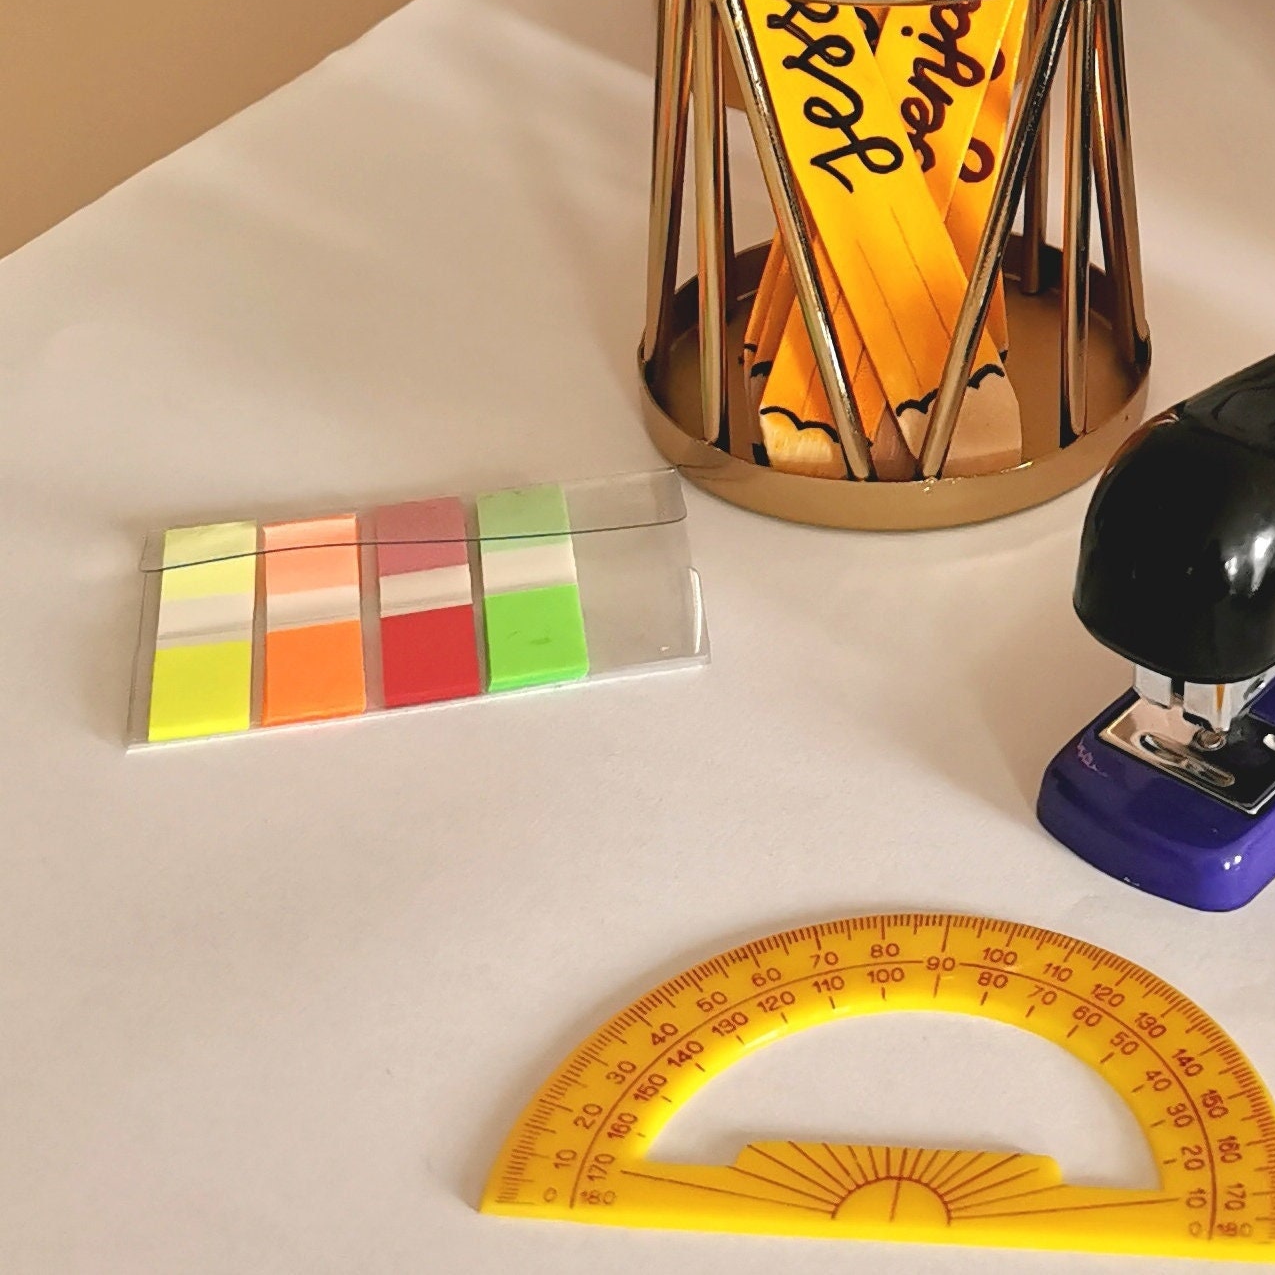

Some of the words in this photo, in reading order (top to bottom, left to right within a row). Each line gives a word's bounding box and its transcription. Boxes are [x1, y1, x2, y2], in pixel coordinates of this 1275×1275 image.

[811, 974, 846, 994] 110
[866, 966, 906, 984] 100
[976, 971, 1009, 990] 80
[756, 990, 797, 1014] 120
[1026, 984, 1058, 1007] 70
[1071, 1005, 1104, 1028] 60
[553, 1148, 578, 1170] 10
[573, 1103, 603, 1130] 20
[605, 1060, 637, 1085] 30
[650, 1022, 679, 1046] 40
[696, 991, 728, 1013] 50
[751, 967, 782, 988] 60
[809, 951, 840, 969] 70
[869, 942, 900, 959] 80
[926, 956, 956, 973] 90
[981, 946, 1019, 966] 100
[1042, 962, 1075, 983] 110
[1089, 982, 1126, 1009] 120
[1133, 1011, 1168, 1040] 130
[1171, 1047, 1204, 1079] 140
[666, 1040, 705, 1068] 140
[1109, 1030, 1139, 1057] 50
[632, 1073, 669, 1103] 150
[1145, 1069, 1173, 1092] 40
[606, 1111, 639, 1140] 160
[1166, 1102, 1195, 1129] 30
[1180, 1144, 1206, 1172] 20
